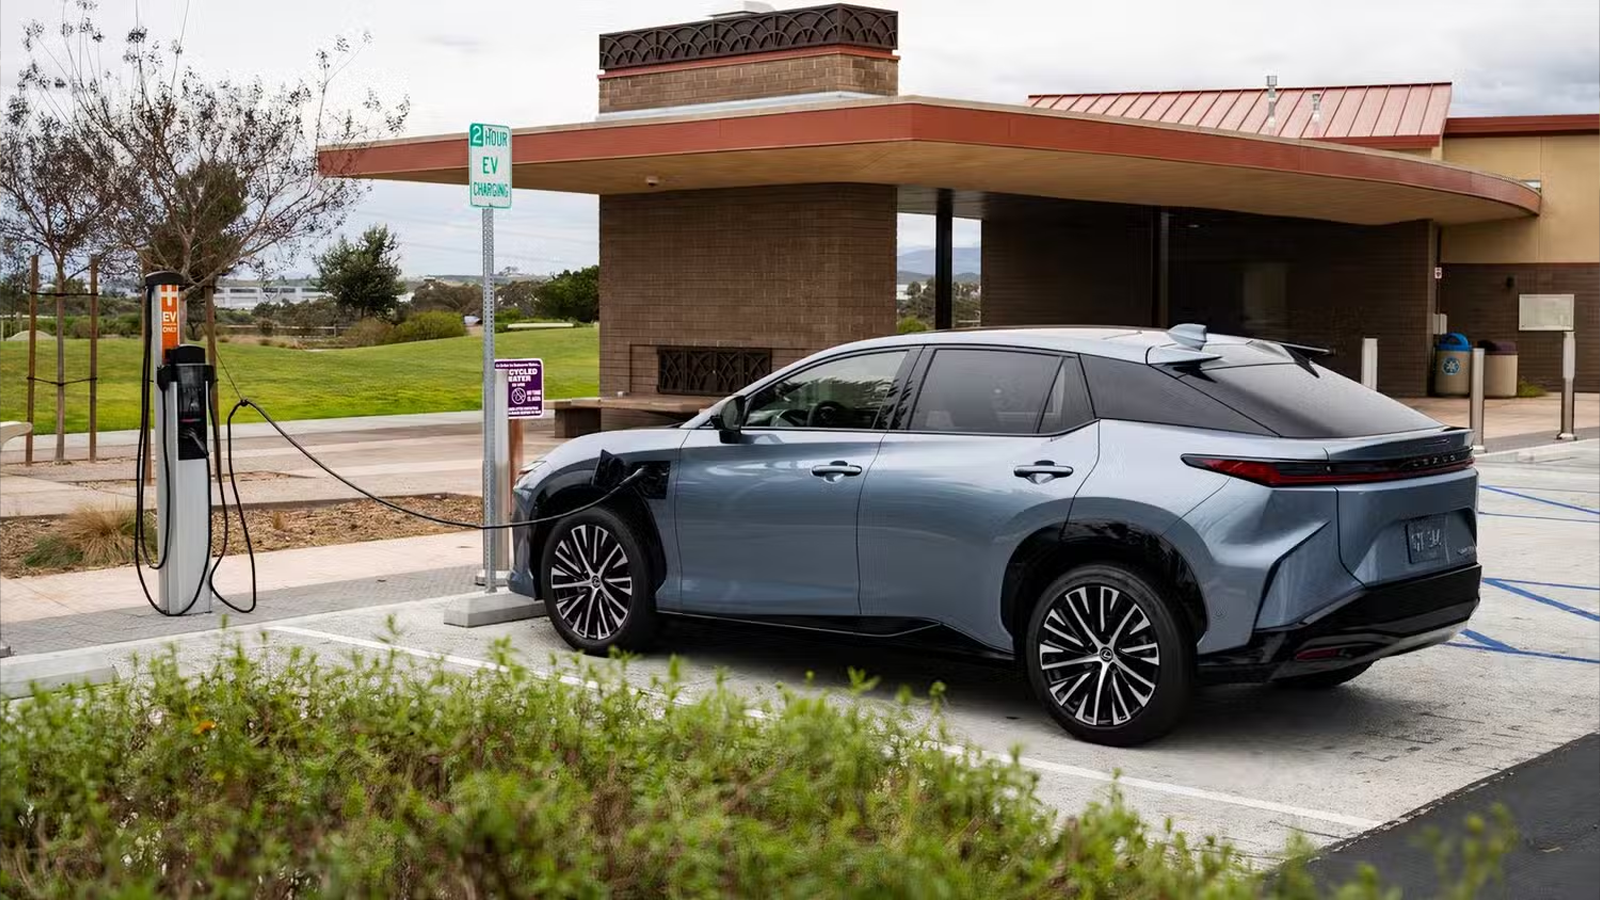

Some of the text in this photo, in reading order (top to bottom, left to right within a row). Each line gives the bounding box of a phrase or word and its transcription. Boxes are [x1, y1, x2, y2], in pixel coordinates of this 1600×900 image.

[472, 125, 508, 146] 2 HOUR
[482, 156, 498, 174] EV
[473, 182, 508, 197] CHARGING
[162, 311, 177, 322] EV
